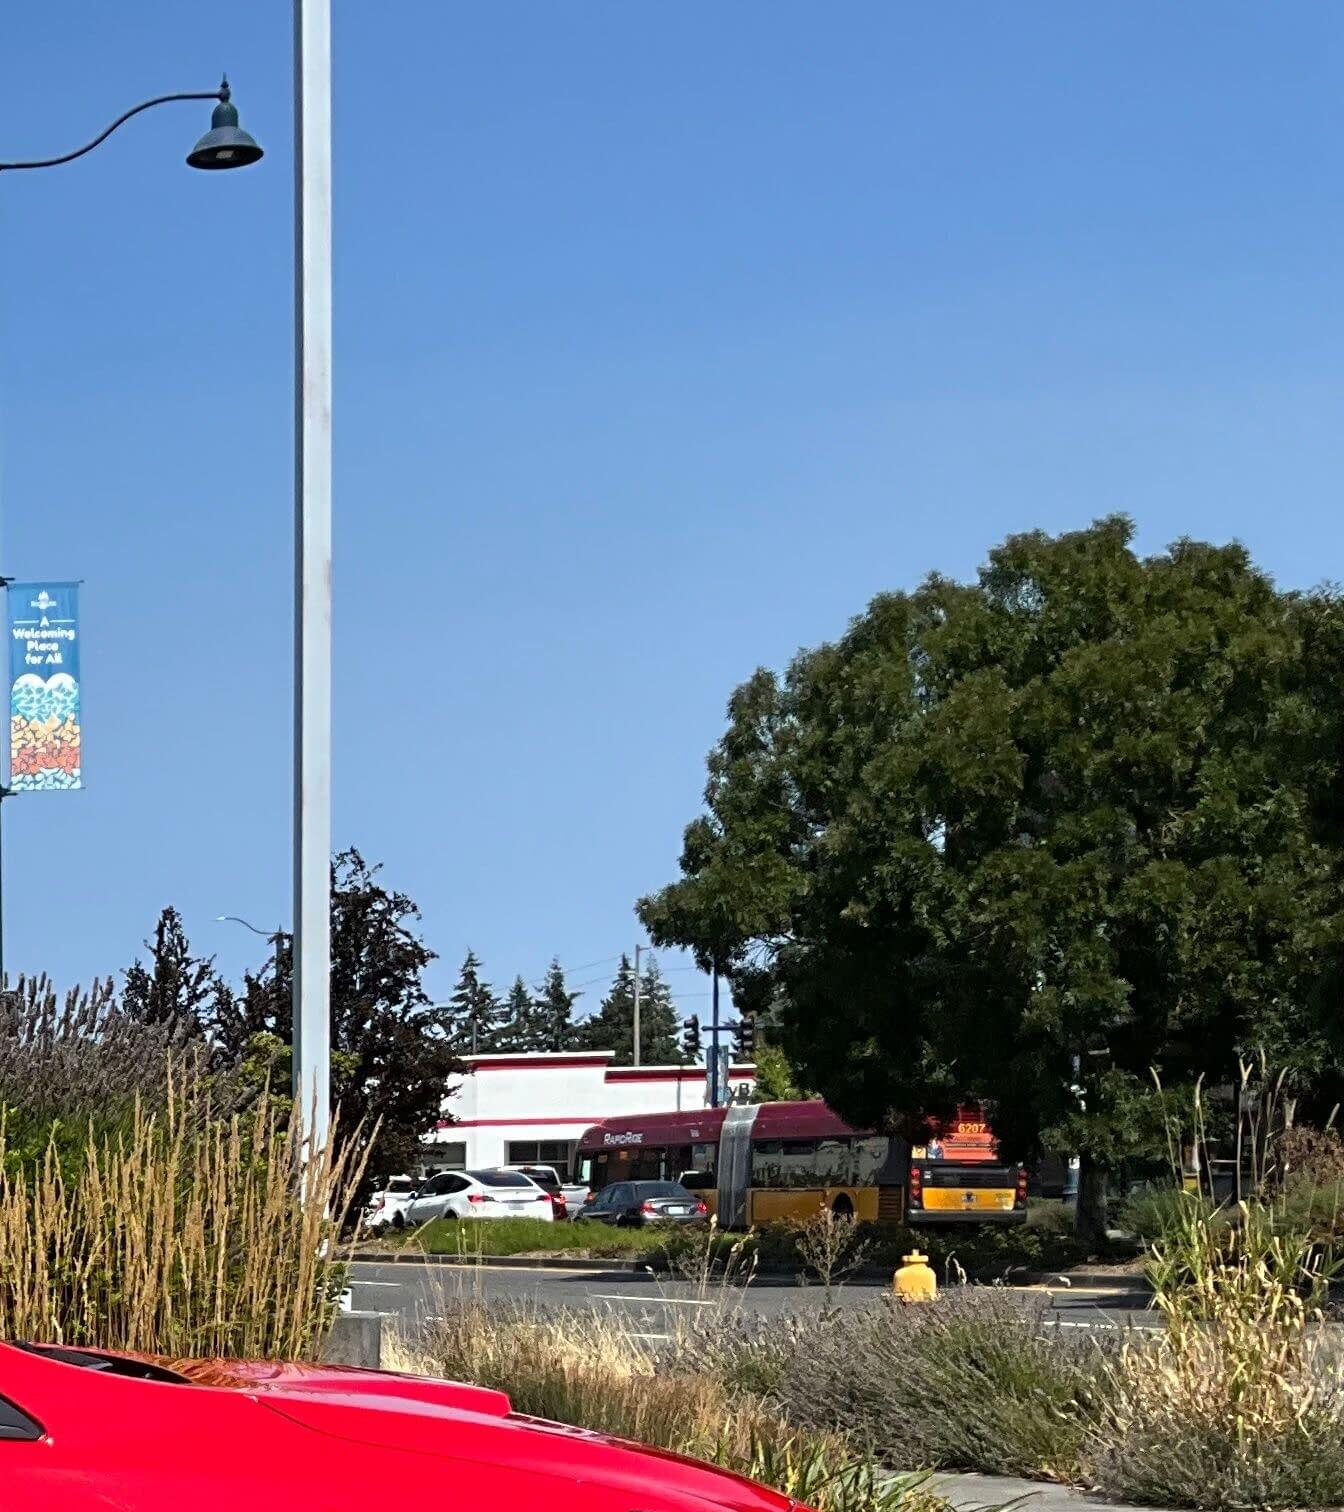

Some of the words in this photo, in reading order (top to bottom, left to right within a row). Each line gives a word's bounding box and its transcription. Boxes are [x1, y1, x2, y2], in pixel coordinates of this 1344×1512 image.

[40, 616, 49, 627] A
[12, 627, 75, 640] Welcoming
[27, 640, 59, 651] Place
[25, 653, 43, 664] for
[45, 652, 63, 664] All
